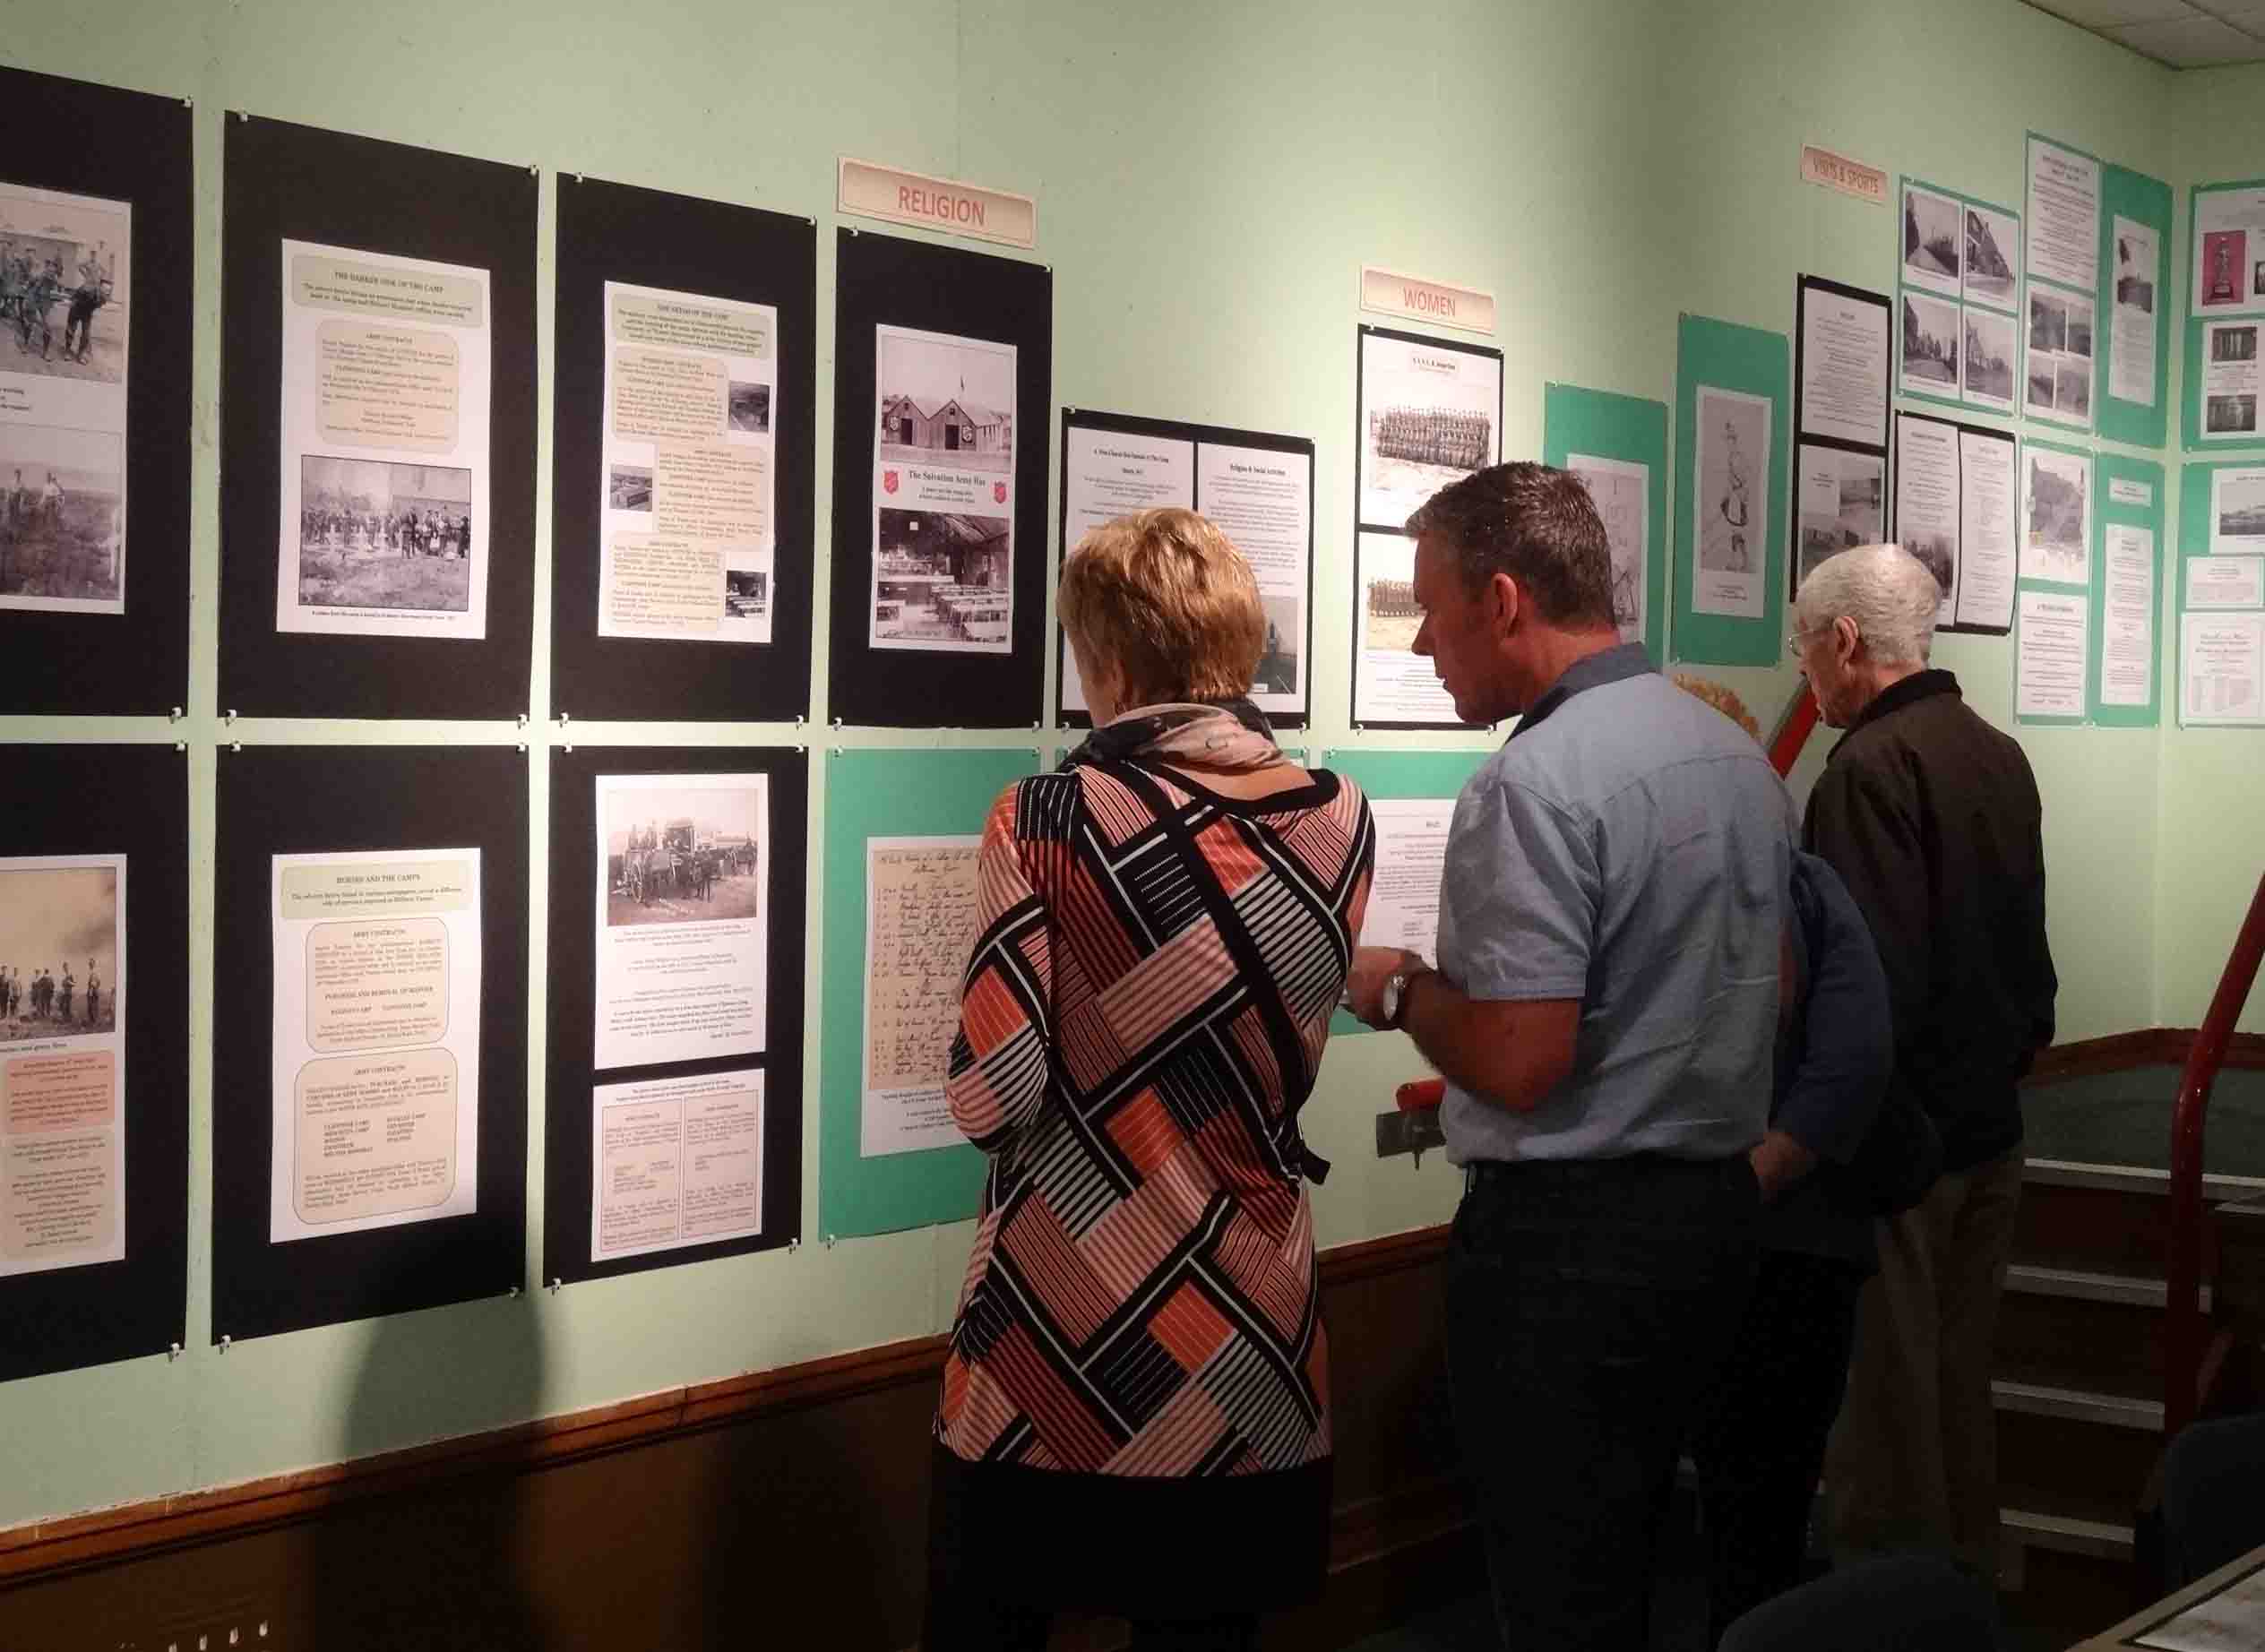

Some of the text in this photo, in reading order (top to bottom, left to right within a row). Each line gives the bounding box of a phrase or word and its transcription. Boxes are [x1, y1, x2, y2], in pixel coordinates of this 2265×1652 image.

[1847, 169, 1879, 194] SPORTS
[899, 185, 985, 226] RELIGION
[1403, 286, 1456, 316] WOMEN
[909, 470, 922, 479] The
[923, 472, 953, 483] Salvation
[381, 874, 395, 882] THE
